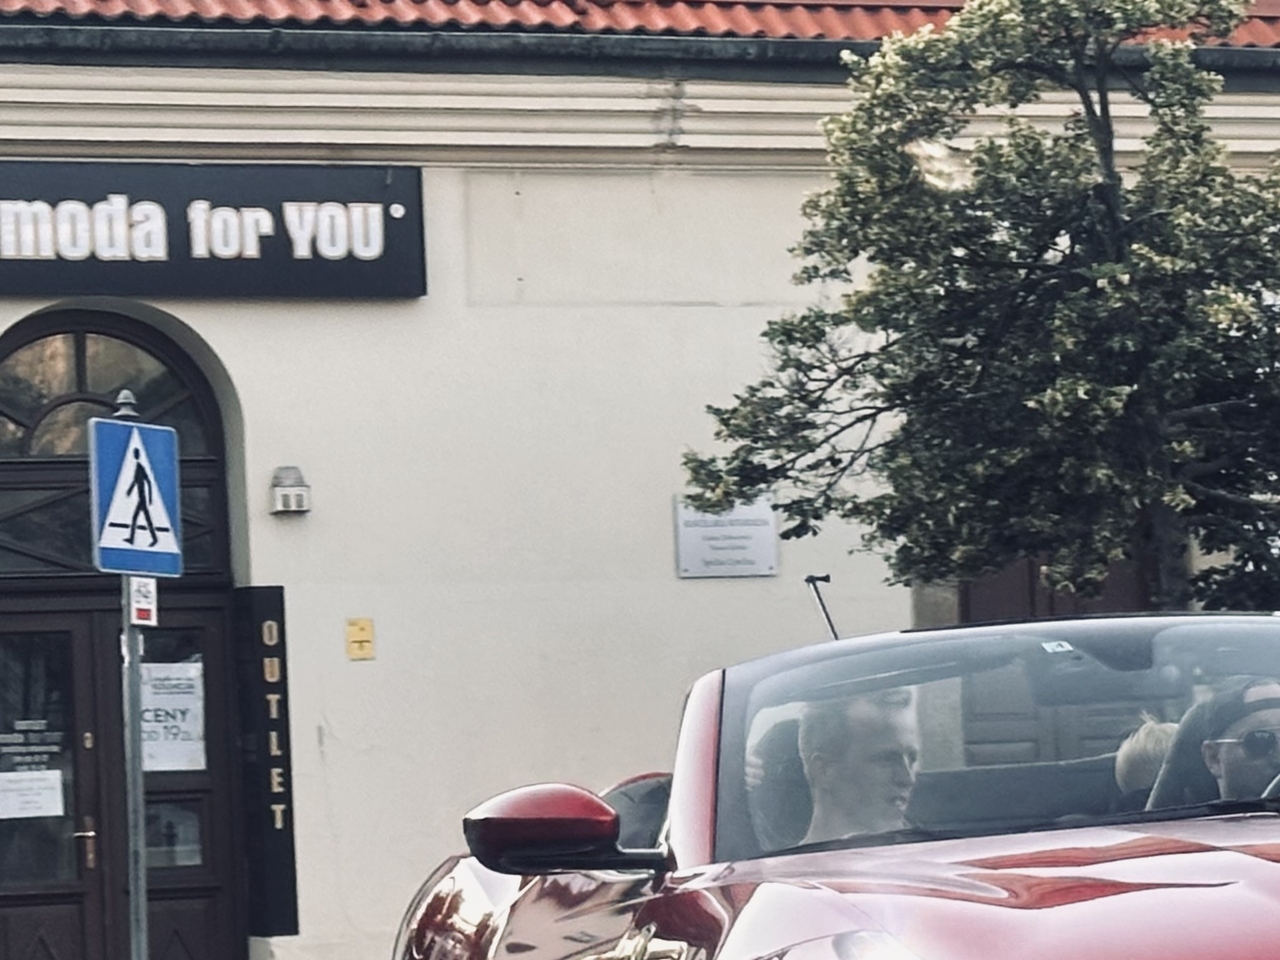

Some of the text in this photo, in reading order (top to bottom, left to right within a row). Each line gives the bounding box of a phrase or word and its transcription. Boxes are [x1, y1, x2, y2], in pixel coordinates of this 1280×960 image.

[0, 194, 168, 261] moda
[187, 199, 275, 260] for
[140, 707, 190, 723] CENY
[262, 620, 286, 829] OUTLET
